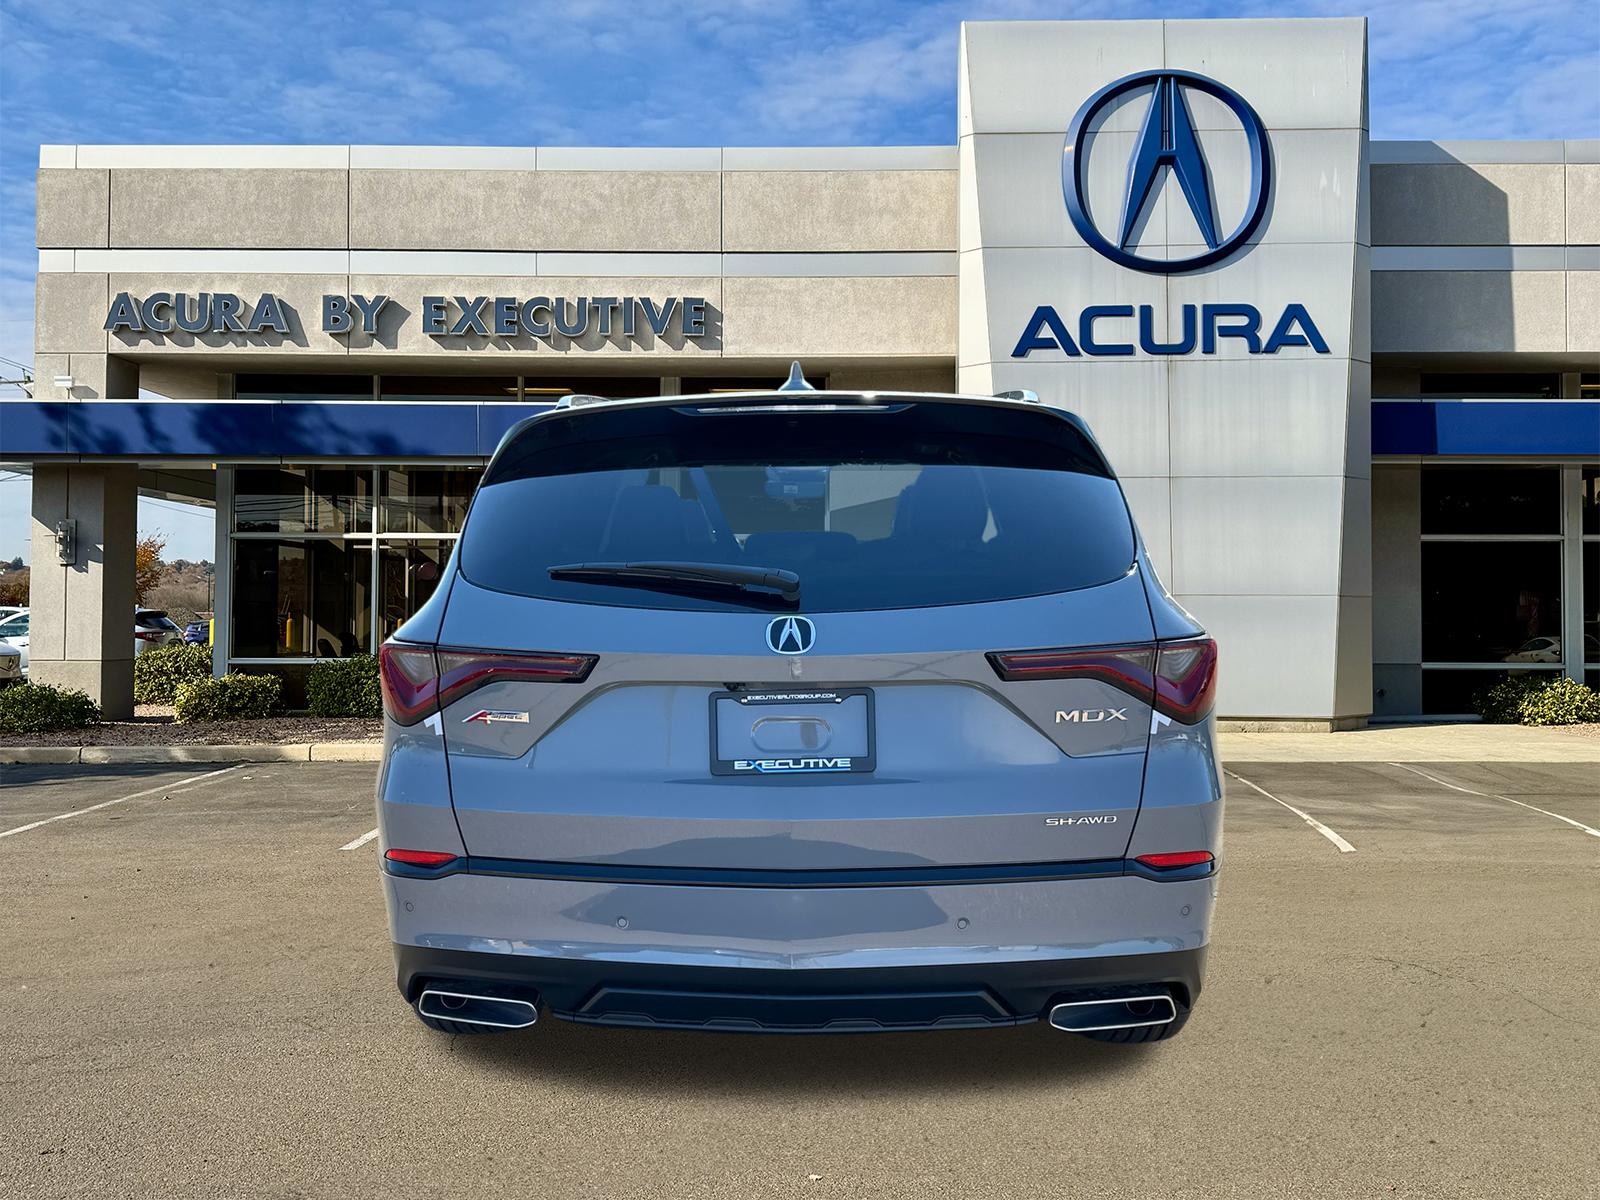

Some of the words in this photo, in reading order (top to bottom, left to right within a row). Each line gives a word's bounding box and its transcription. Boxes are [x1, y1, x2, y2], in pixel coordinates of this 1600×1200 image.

[103, 292, 290, 334] ACURA
[322, 294, 391, 335] BY
[421, 296, 706, 337] EXECUTIVE
[1011, 303, 1331, 357] ACURA
[747, 692, 837, 701] EXECUTIVEAUTOGROUP.COM
[1055, 708, 1128, 723] MDX
[733, 758, 851, 772] EXECUTIVE
[1045, 815, 1118, 826] SH-AWD
